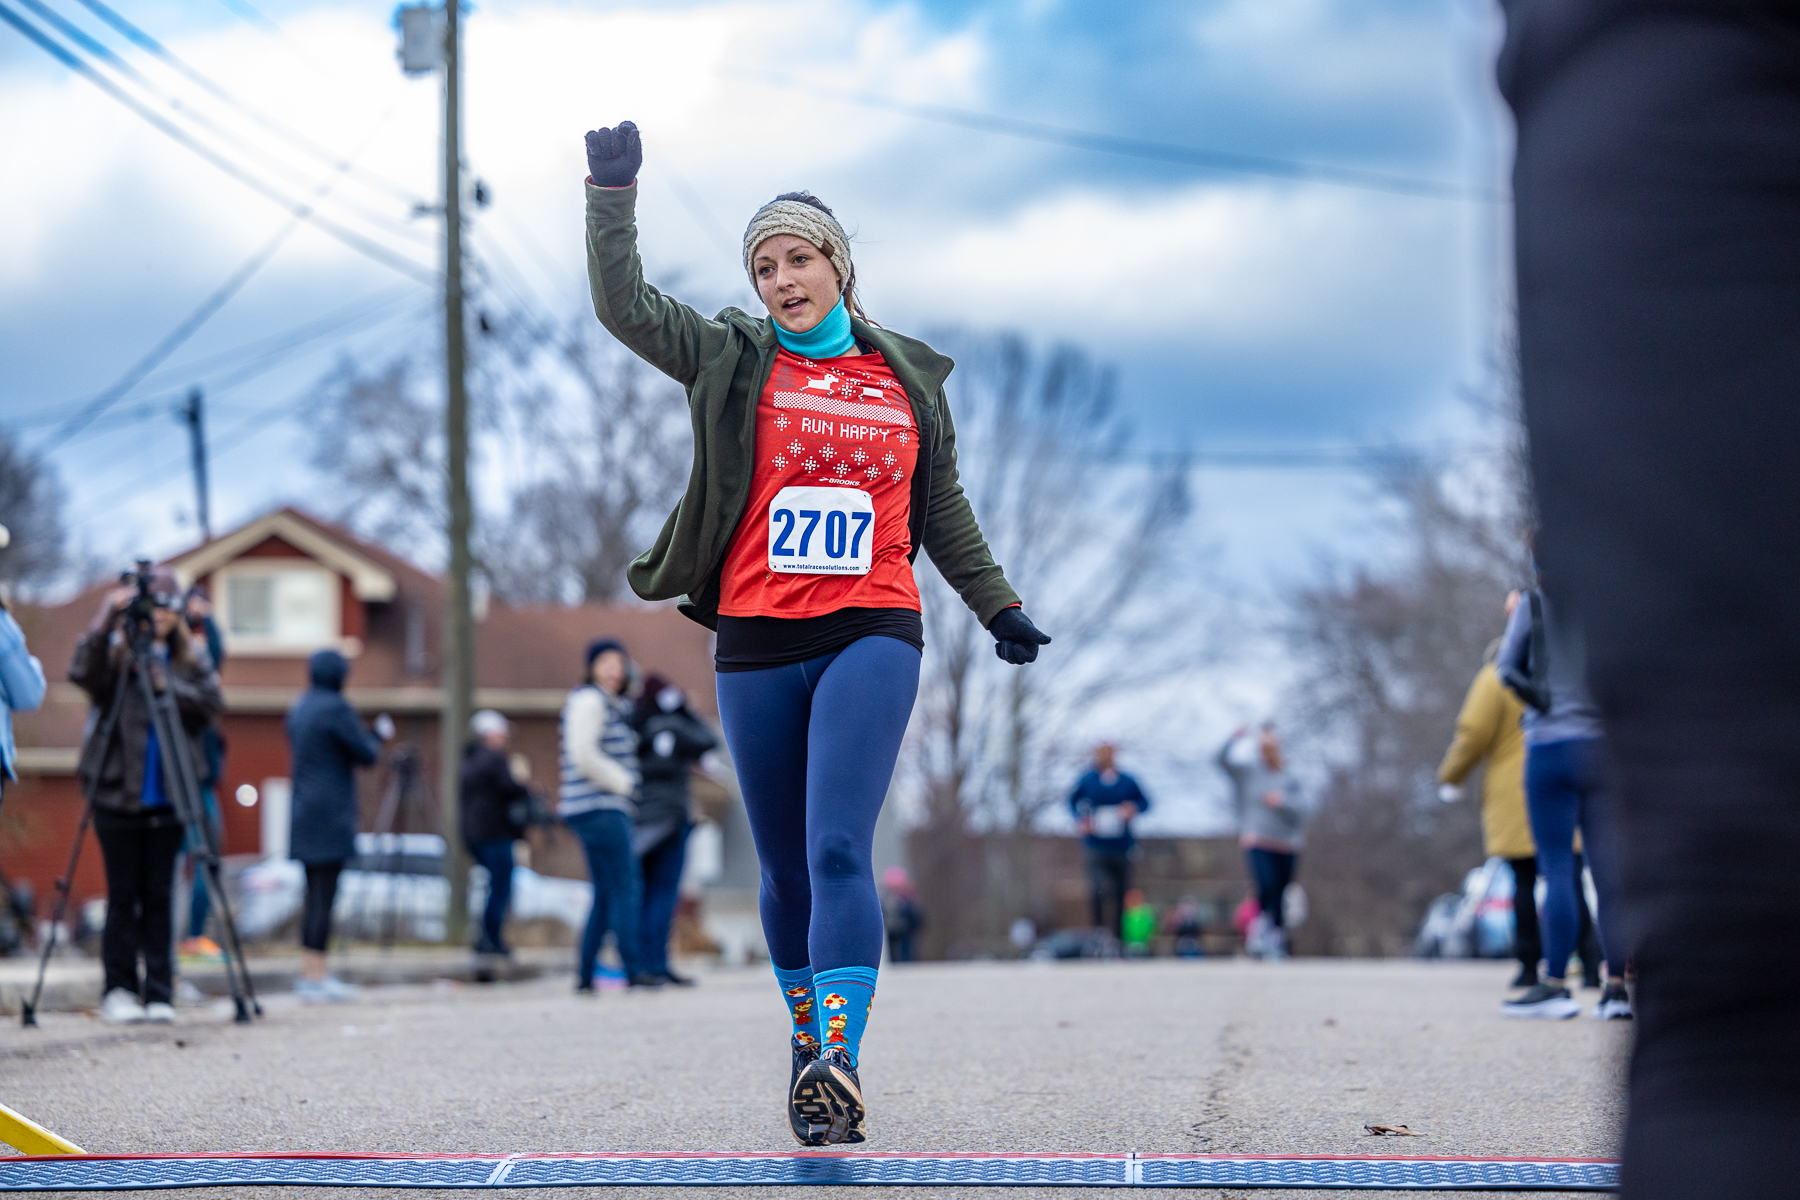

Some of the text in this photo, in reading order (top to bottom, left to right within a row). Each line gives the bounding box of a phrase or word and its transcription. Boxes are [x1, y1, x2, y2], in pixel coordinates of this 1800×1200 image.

[801, 417, 890, 442] RUN HAPPY
[828, 478, 860, 486] BROOKS
[772, 508, 872, 558] 2707
